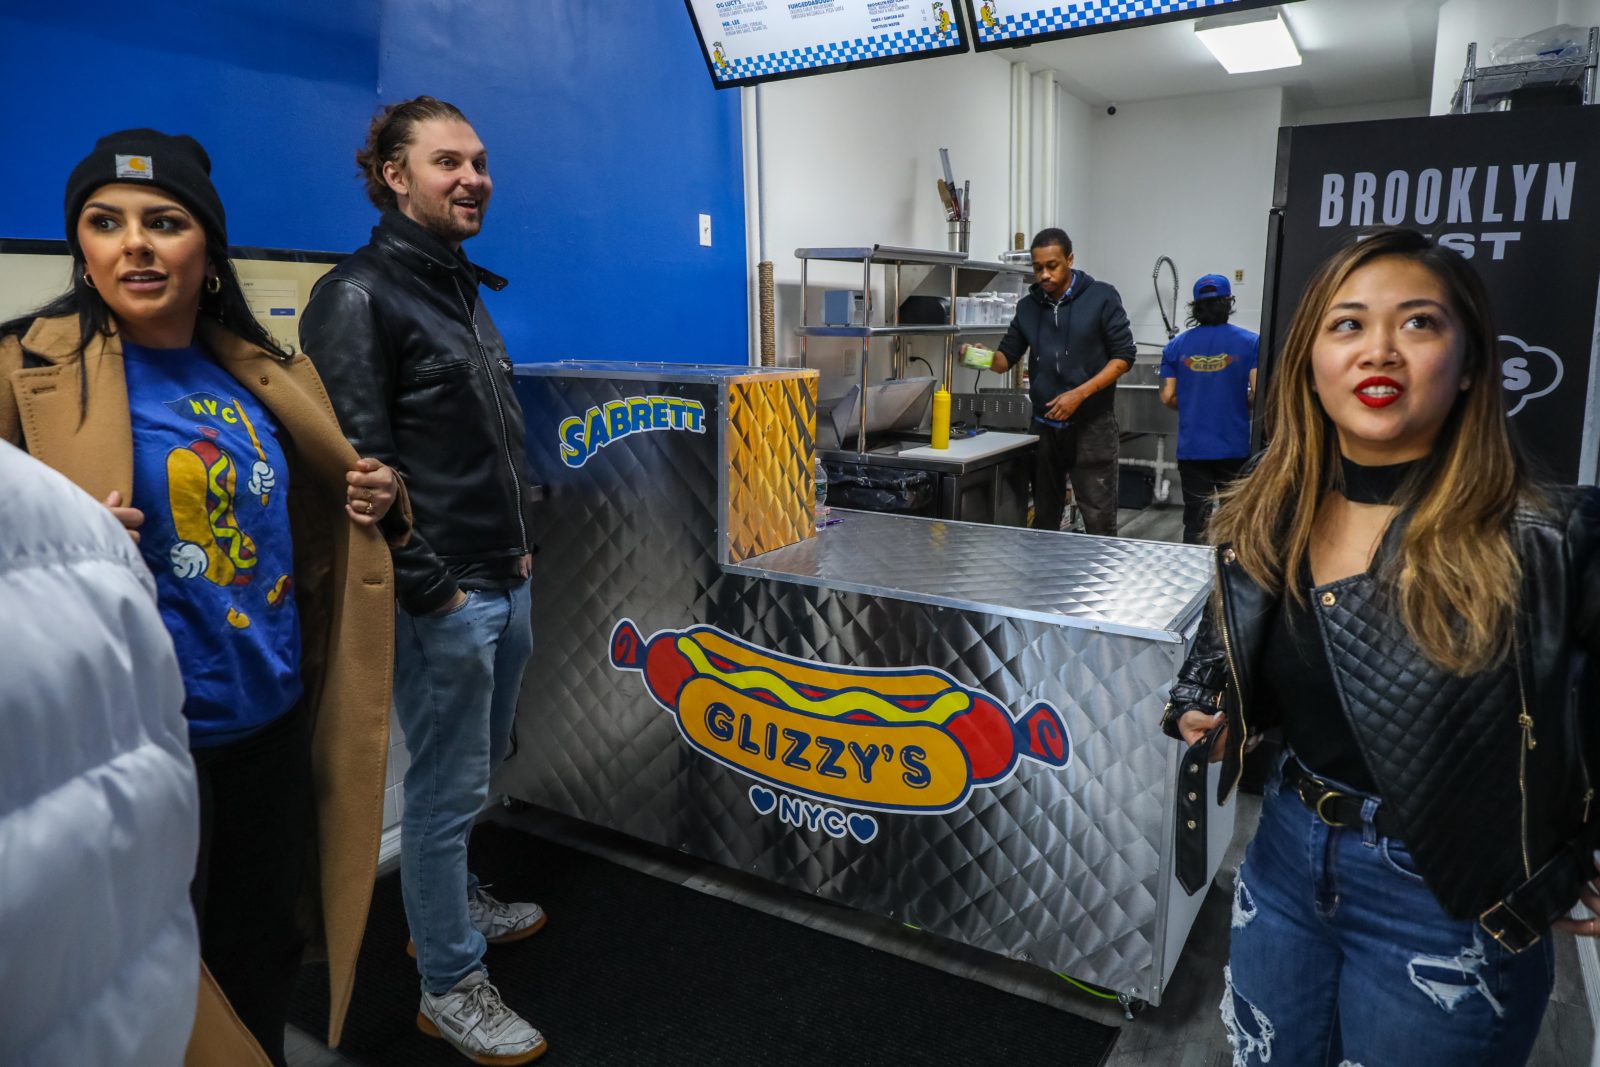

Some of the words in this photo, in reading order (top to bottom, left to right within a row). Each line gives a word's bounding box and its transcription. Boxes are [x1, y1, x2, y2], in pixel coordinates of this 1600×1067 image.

[1319, 161, 1577, 228] BROOKLYN
[189, 399, 238, 424] NYC
[559, 396, 705, 468] SABRETT
[704, 702, 932, 789] GLIZZY'S
[779, 795, 847, 838] NYC
